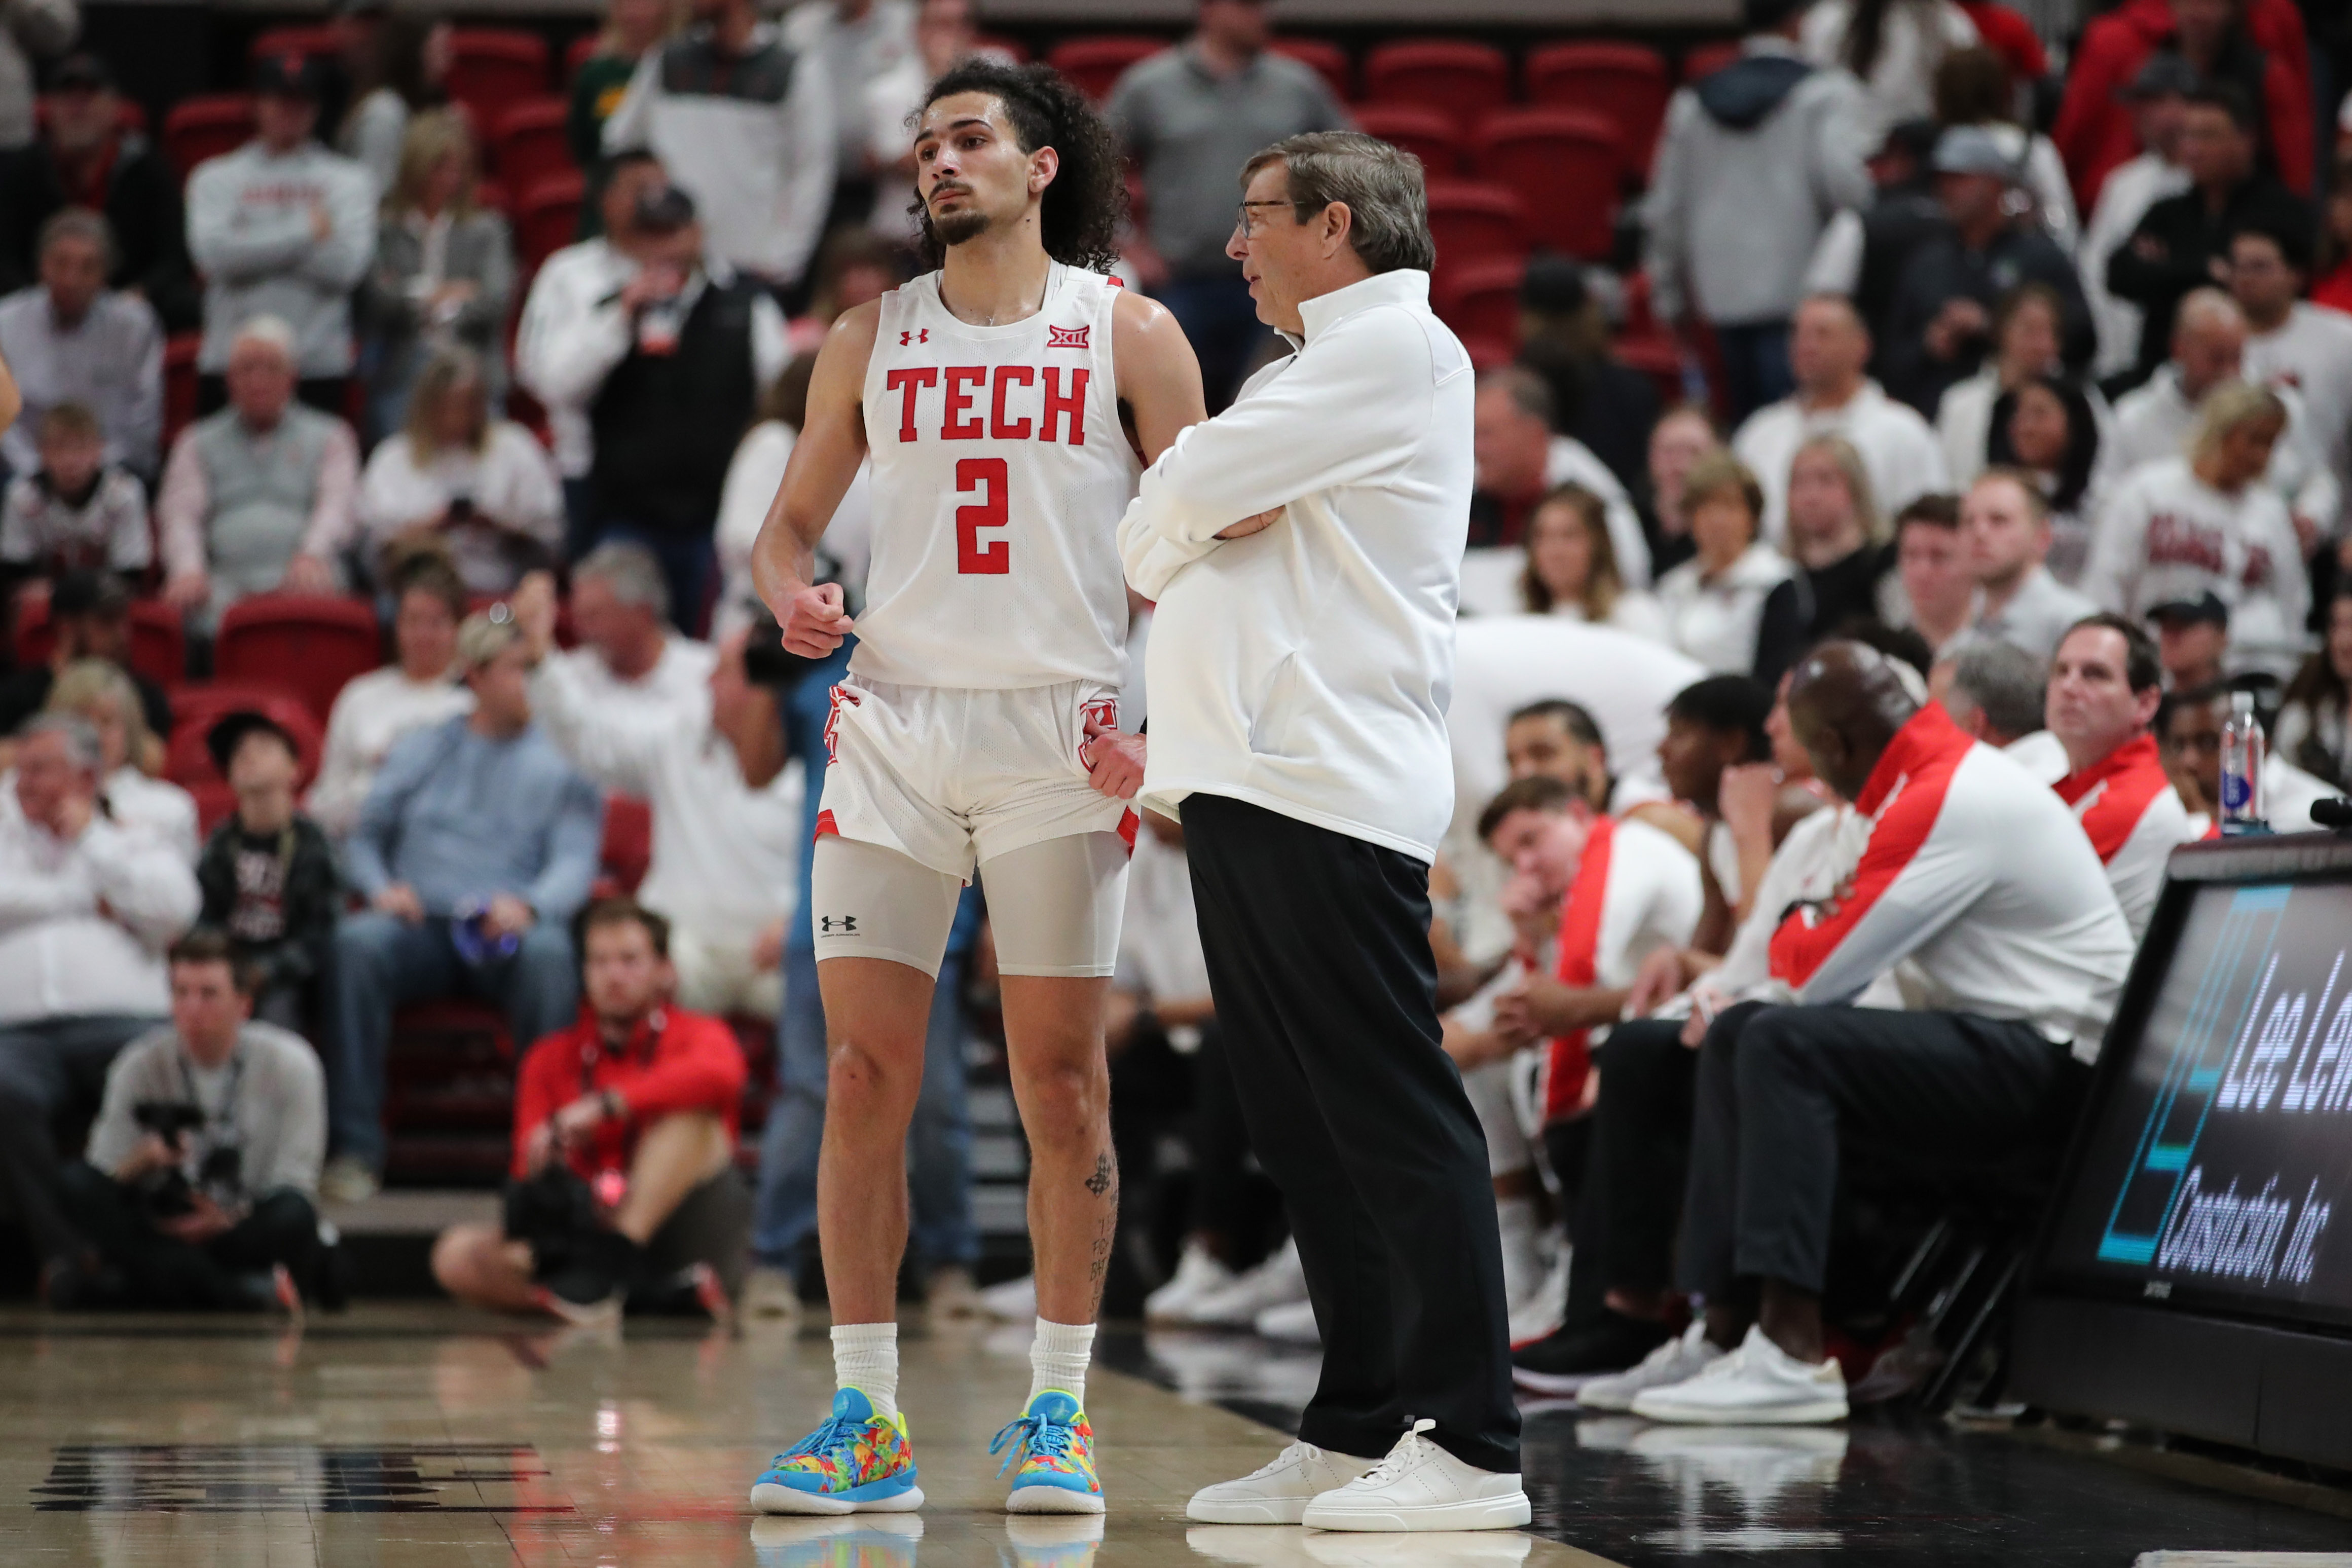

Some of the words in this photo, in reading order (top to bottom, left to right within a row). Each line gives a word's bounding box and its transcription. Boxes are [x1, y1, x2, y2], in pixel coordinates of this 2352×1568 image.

[1048, 325, 1089, 348] XII
[887, 366, 1089, 445] TECH
[956, 458, 1009, 574] 2
[2217, 951, 2308, 1112] Lee
[2281, 949, 2352, 1113] Lew
